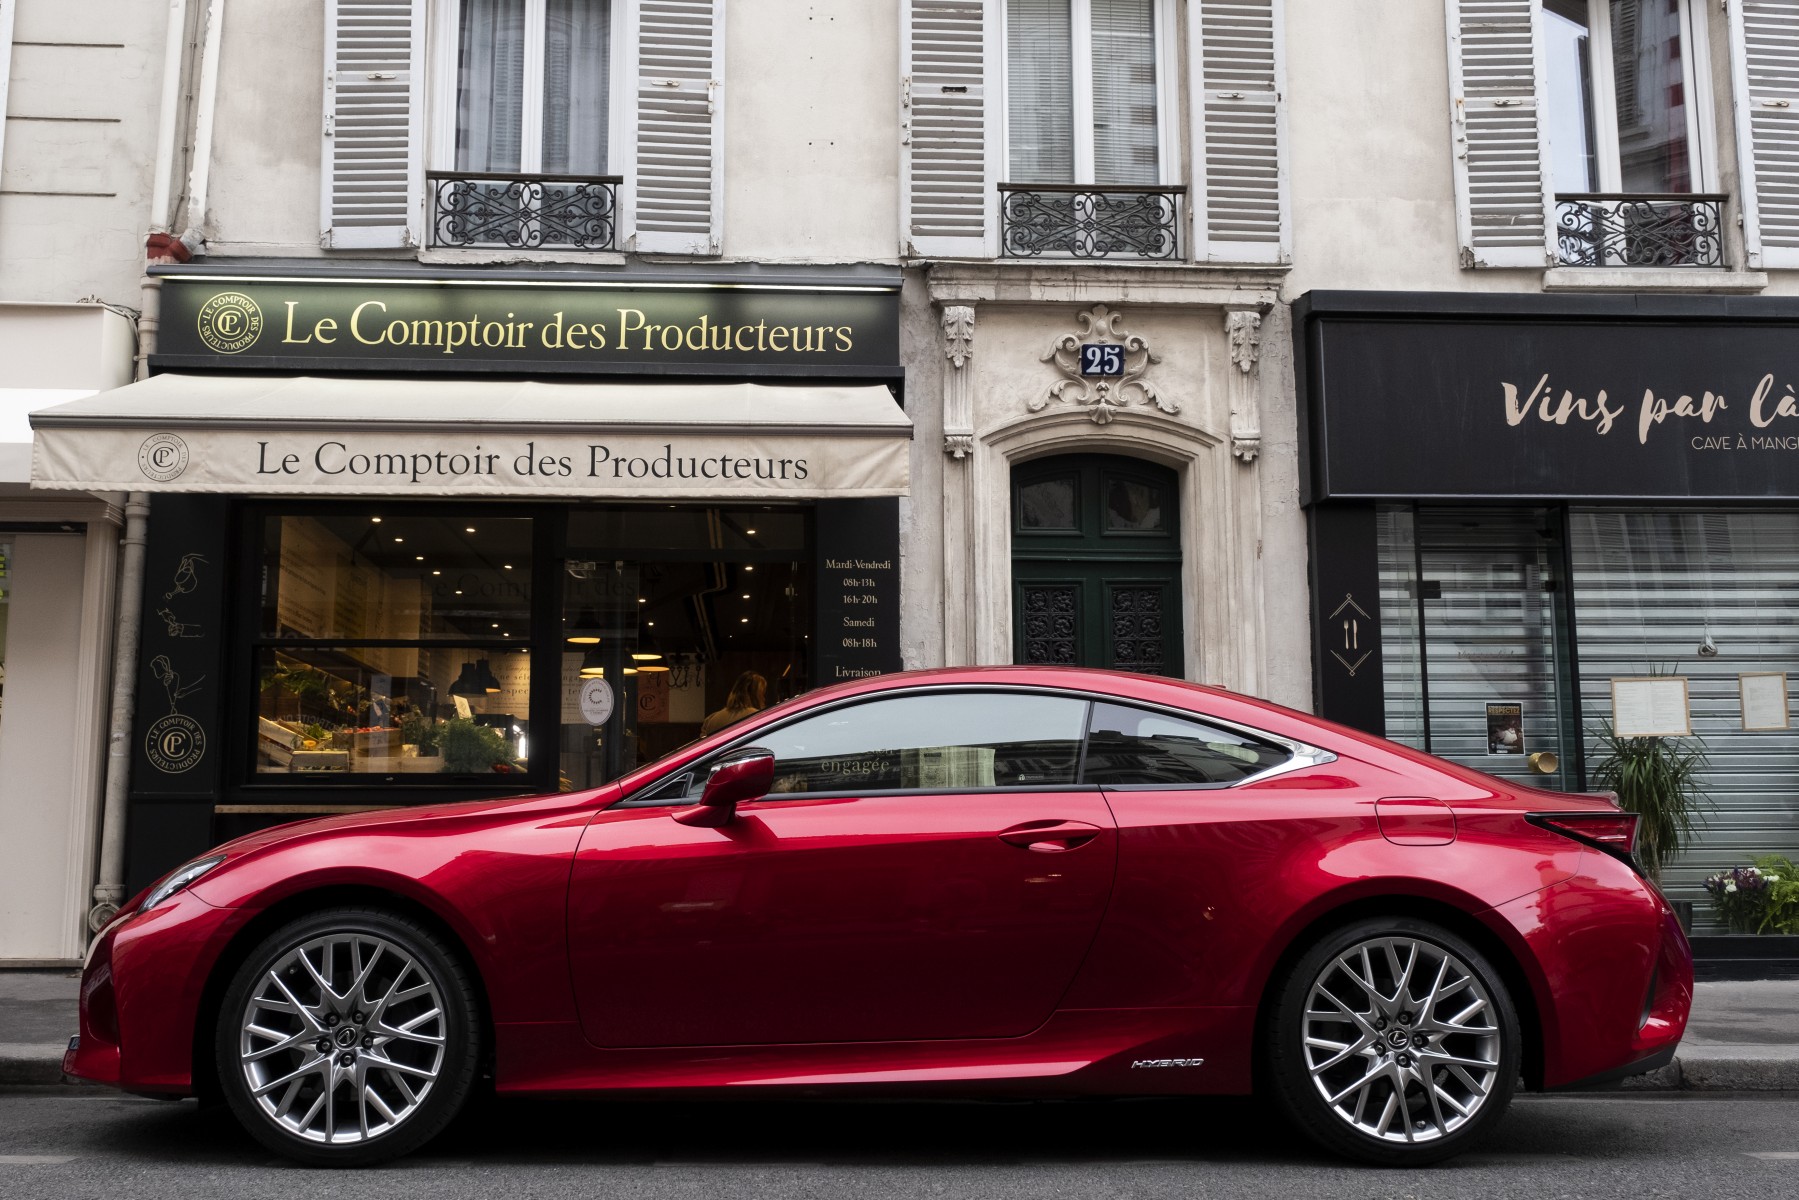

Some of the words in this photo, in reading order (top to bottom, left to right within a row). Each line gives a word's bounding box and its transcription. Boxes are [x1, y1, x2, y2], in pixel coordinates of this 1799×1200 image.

[213, 296, 255, 314] COMPTOIR
[203, 308, 214, 319] LE
[251, 317, 259, 331] DES
[282, 301, 338, 344] Le
[350, 300, 534, 354] Comptoir
[541, 311, 606, 350] des
[616, 308, 854, 352] Producteurs
[202, 325, 255, 350] PRODUCTEURS
[1086, 346, 1120, 374] 25
[1501, 374, 1625, 435] Vins
[1638, 388, 1729, 445] par
[1749, 373, 1799, 428] là
[153, 436, 183, 447] COMPTOIR
[1691, 436, 1732, 450] CAVE
[1736, 432, 1748, 450] À
[1751, 436, 1799, 450] MANG
[256, 441, 301, 475] Le
[314, 441, 500, 483] Comptoir
[513, 441, 572, 477] des
[587, 443, 809, 480] Producteurs
[825, 559, 891, 570] Mardi-Vendredi
[843, 578, 876, 587] 08h-13h
[843, 616, 875, 627] Samedi
[842, 638, 877, 648] 08h-18h
[835, 665, 881, 677] Livraison
[160, 718, 195, 730] COMPTOIR
[151, 729, 160, 739] LE
[150, 749, 200, 769] PRODUCTEURS
[821, 757, 890, 775] engagée
[1130, 1058, 1205, 1069] HYBRID
